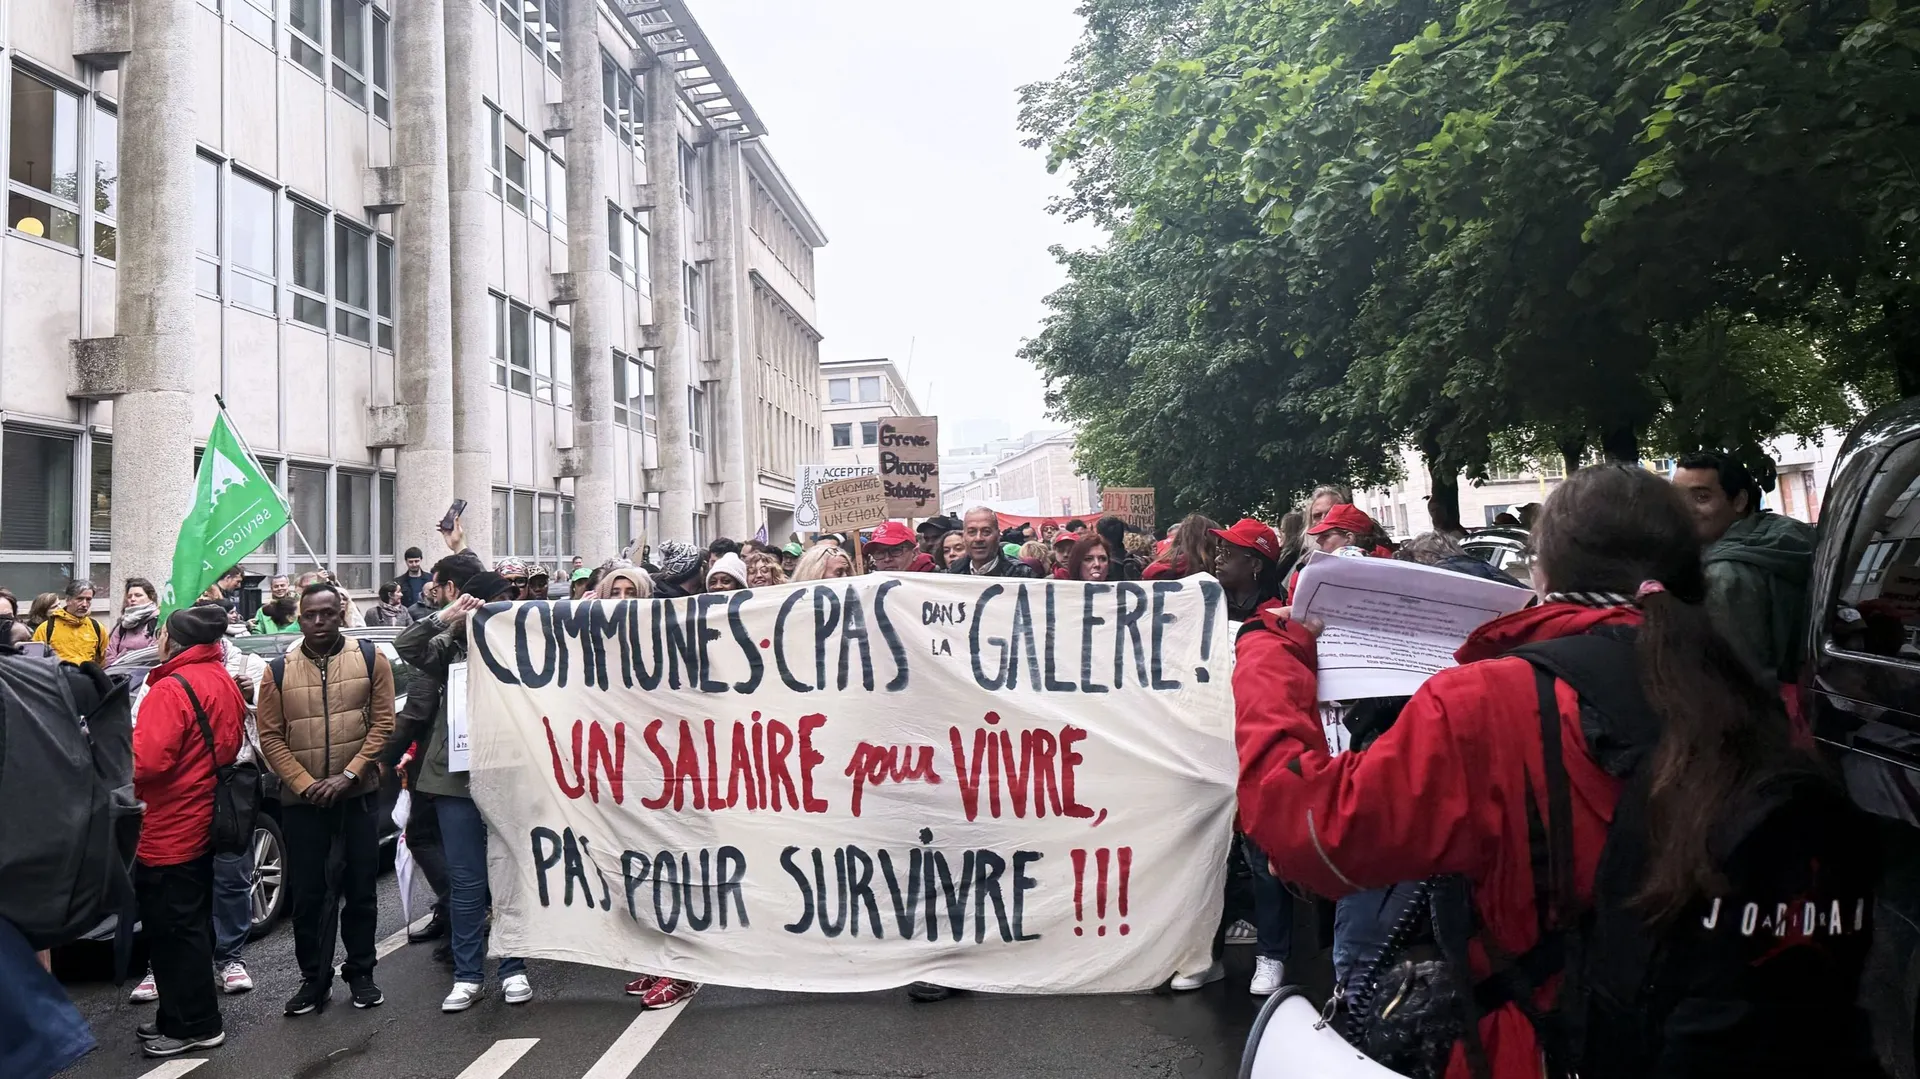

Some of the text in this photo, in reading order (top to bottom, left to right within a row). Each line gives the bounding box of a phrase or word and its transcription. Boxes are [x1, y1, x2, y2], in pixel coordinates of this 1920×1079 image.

[866, 493, 880, 502] PAS
[824, 506, 886, 527] UN CHOIX
[921, 600, 967, 626] DANS
[931, 638, 952, 657] LA
[541, 715, 625, 805] UN
[844, 741, 942, 817] pour
[620, 845, 750, 934] POUR
